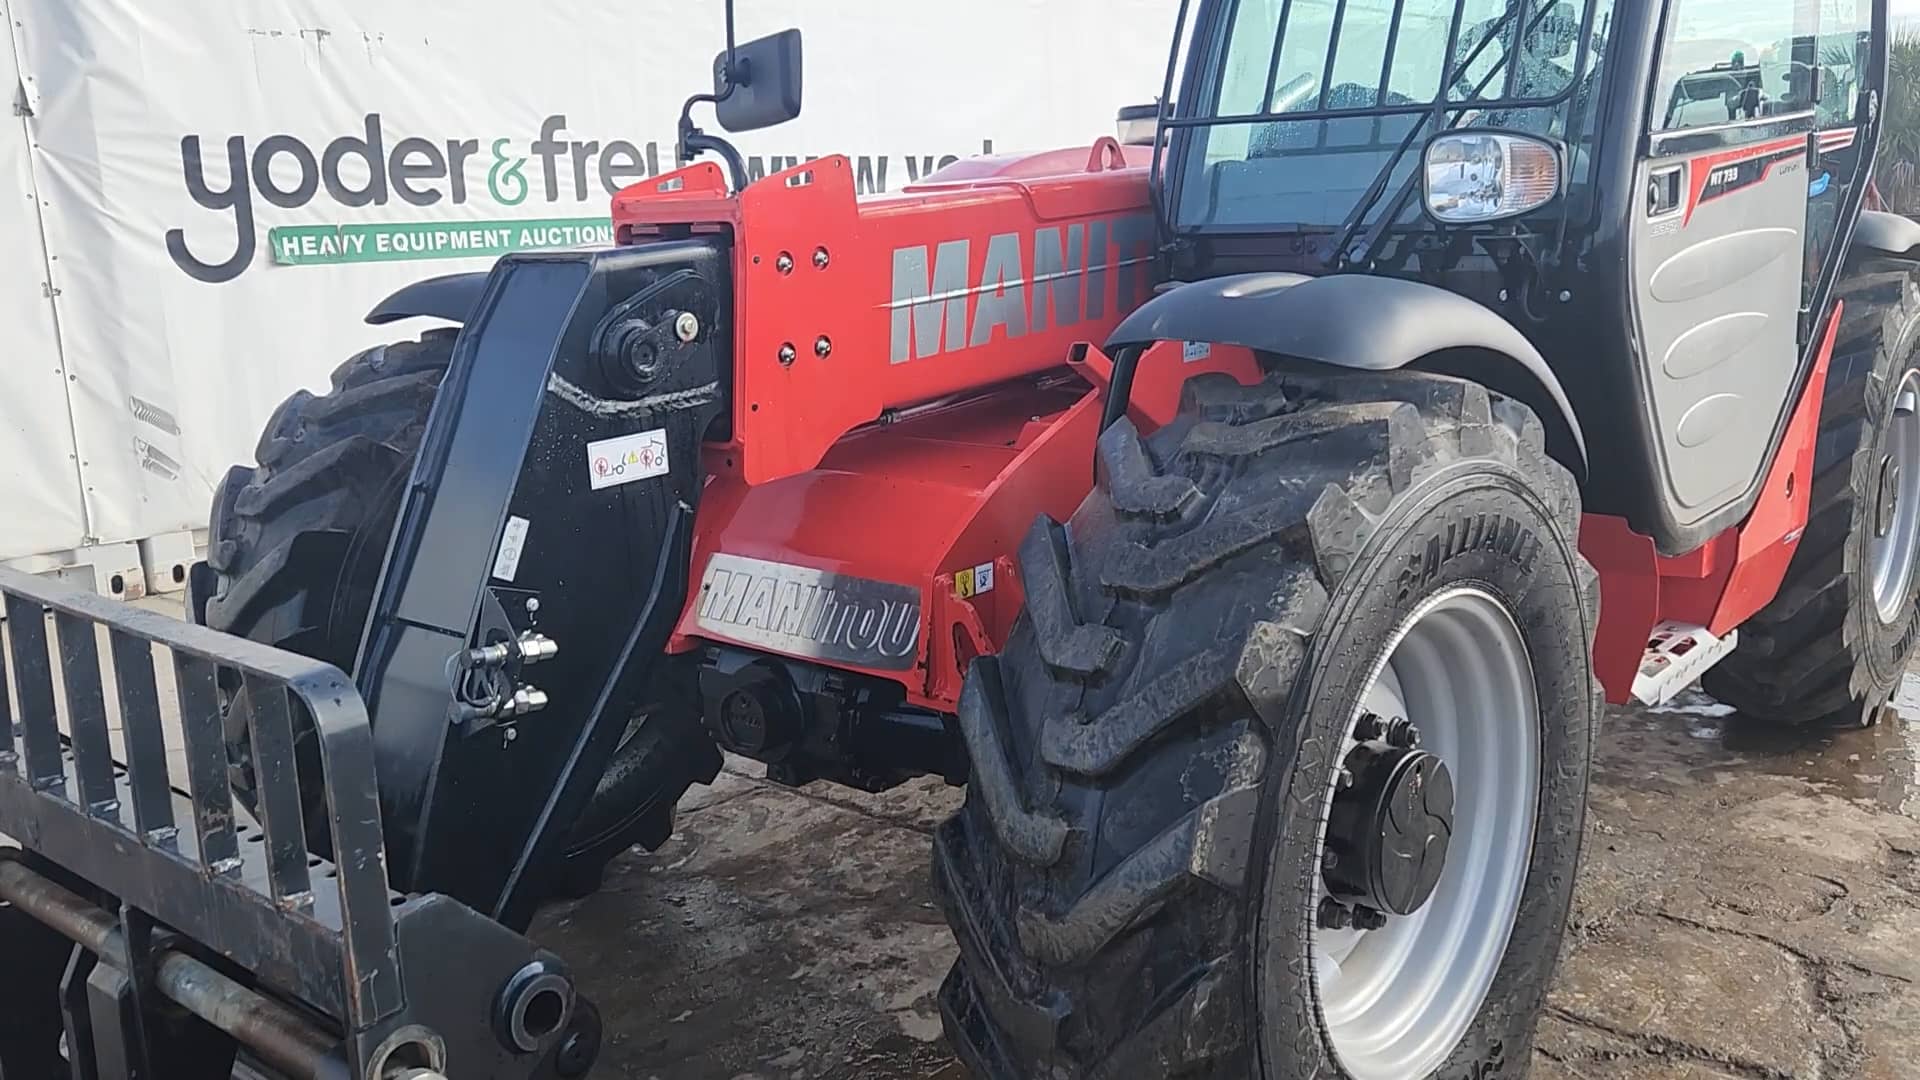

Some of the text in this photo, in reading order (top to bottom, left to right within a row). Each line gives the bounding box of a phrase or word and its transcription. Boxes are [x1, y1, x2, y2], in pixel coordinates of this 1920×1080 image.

[281, 234, 366, 257] HEAVY
[375, 229, 512, 253] EQUIPMENT
[699, 568, 922, 657] MANITOU
